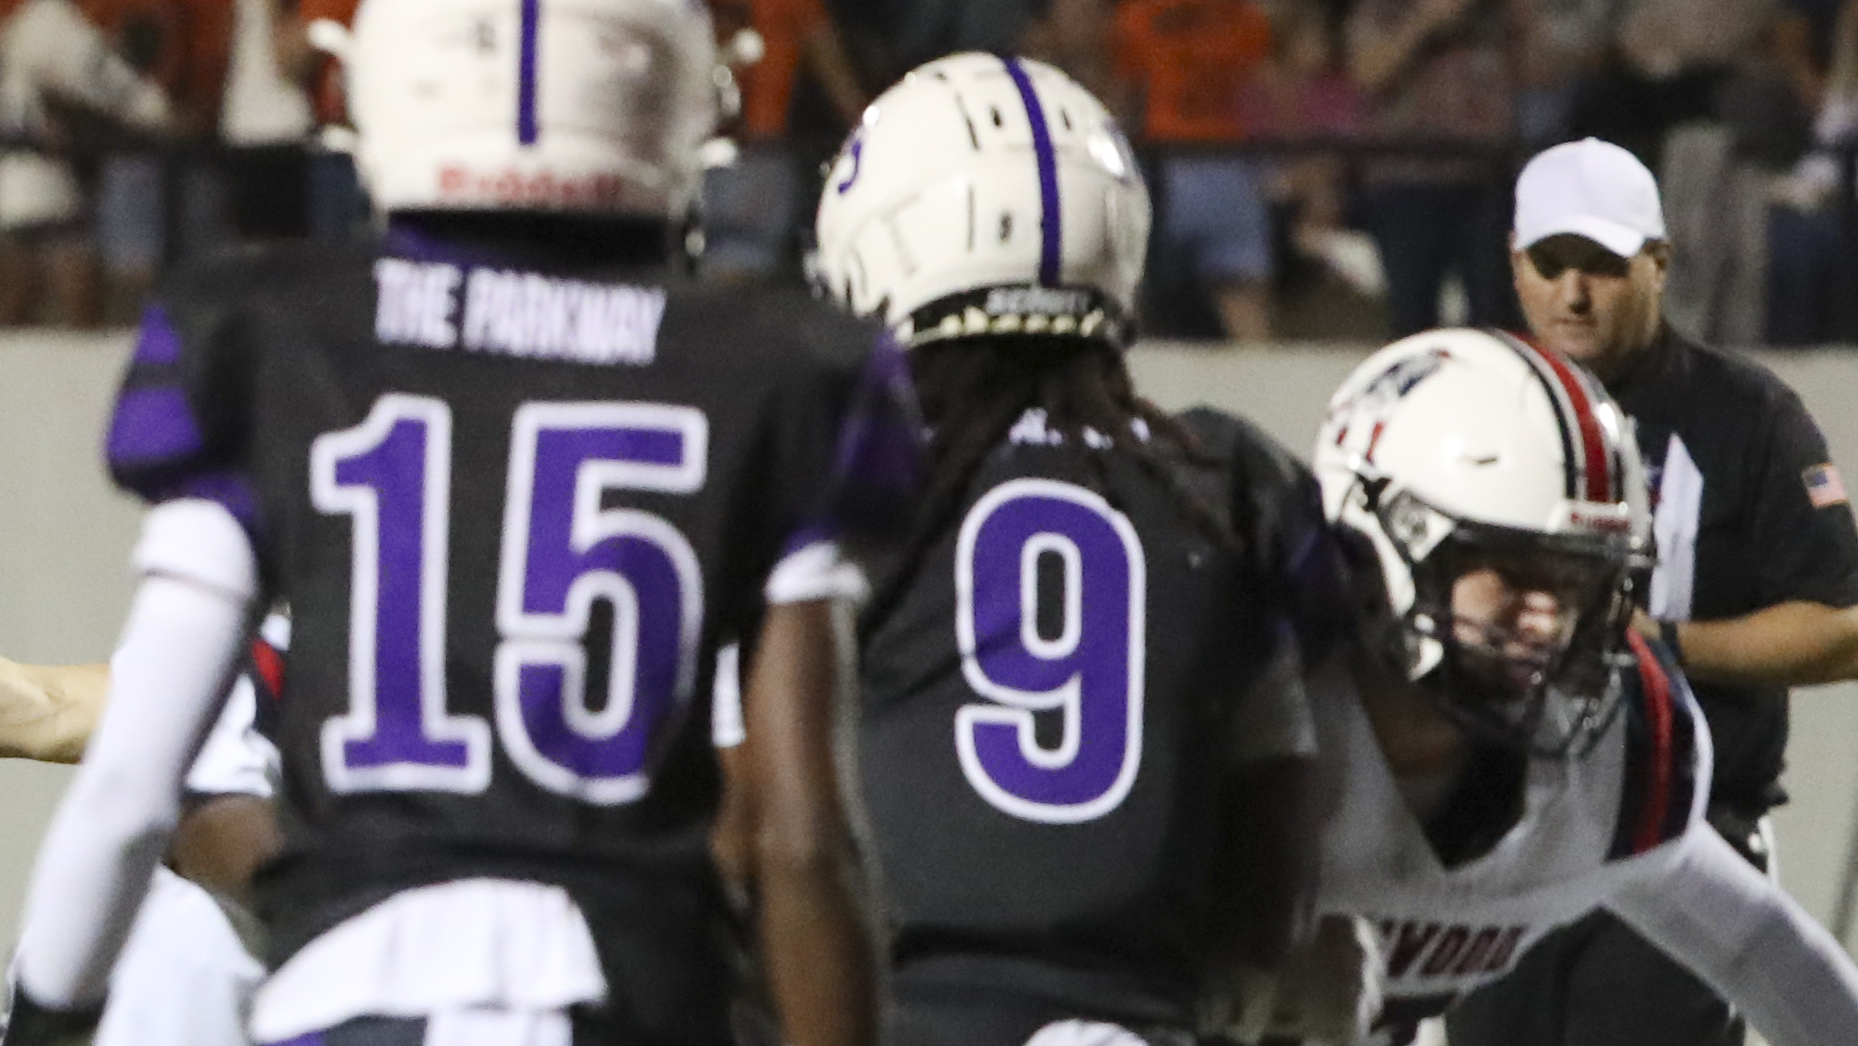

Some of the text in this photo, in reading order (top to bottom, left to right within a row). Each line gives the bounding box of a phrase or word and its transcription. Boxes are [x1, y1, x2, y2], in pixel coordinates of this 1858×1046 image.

[373, 257, 668, 366] THE PARKWAY
[310, 393, 709, 806] 15
[954, 478, 1146, 824] 9
